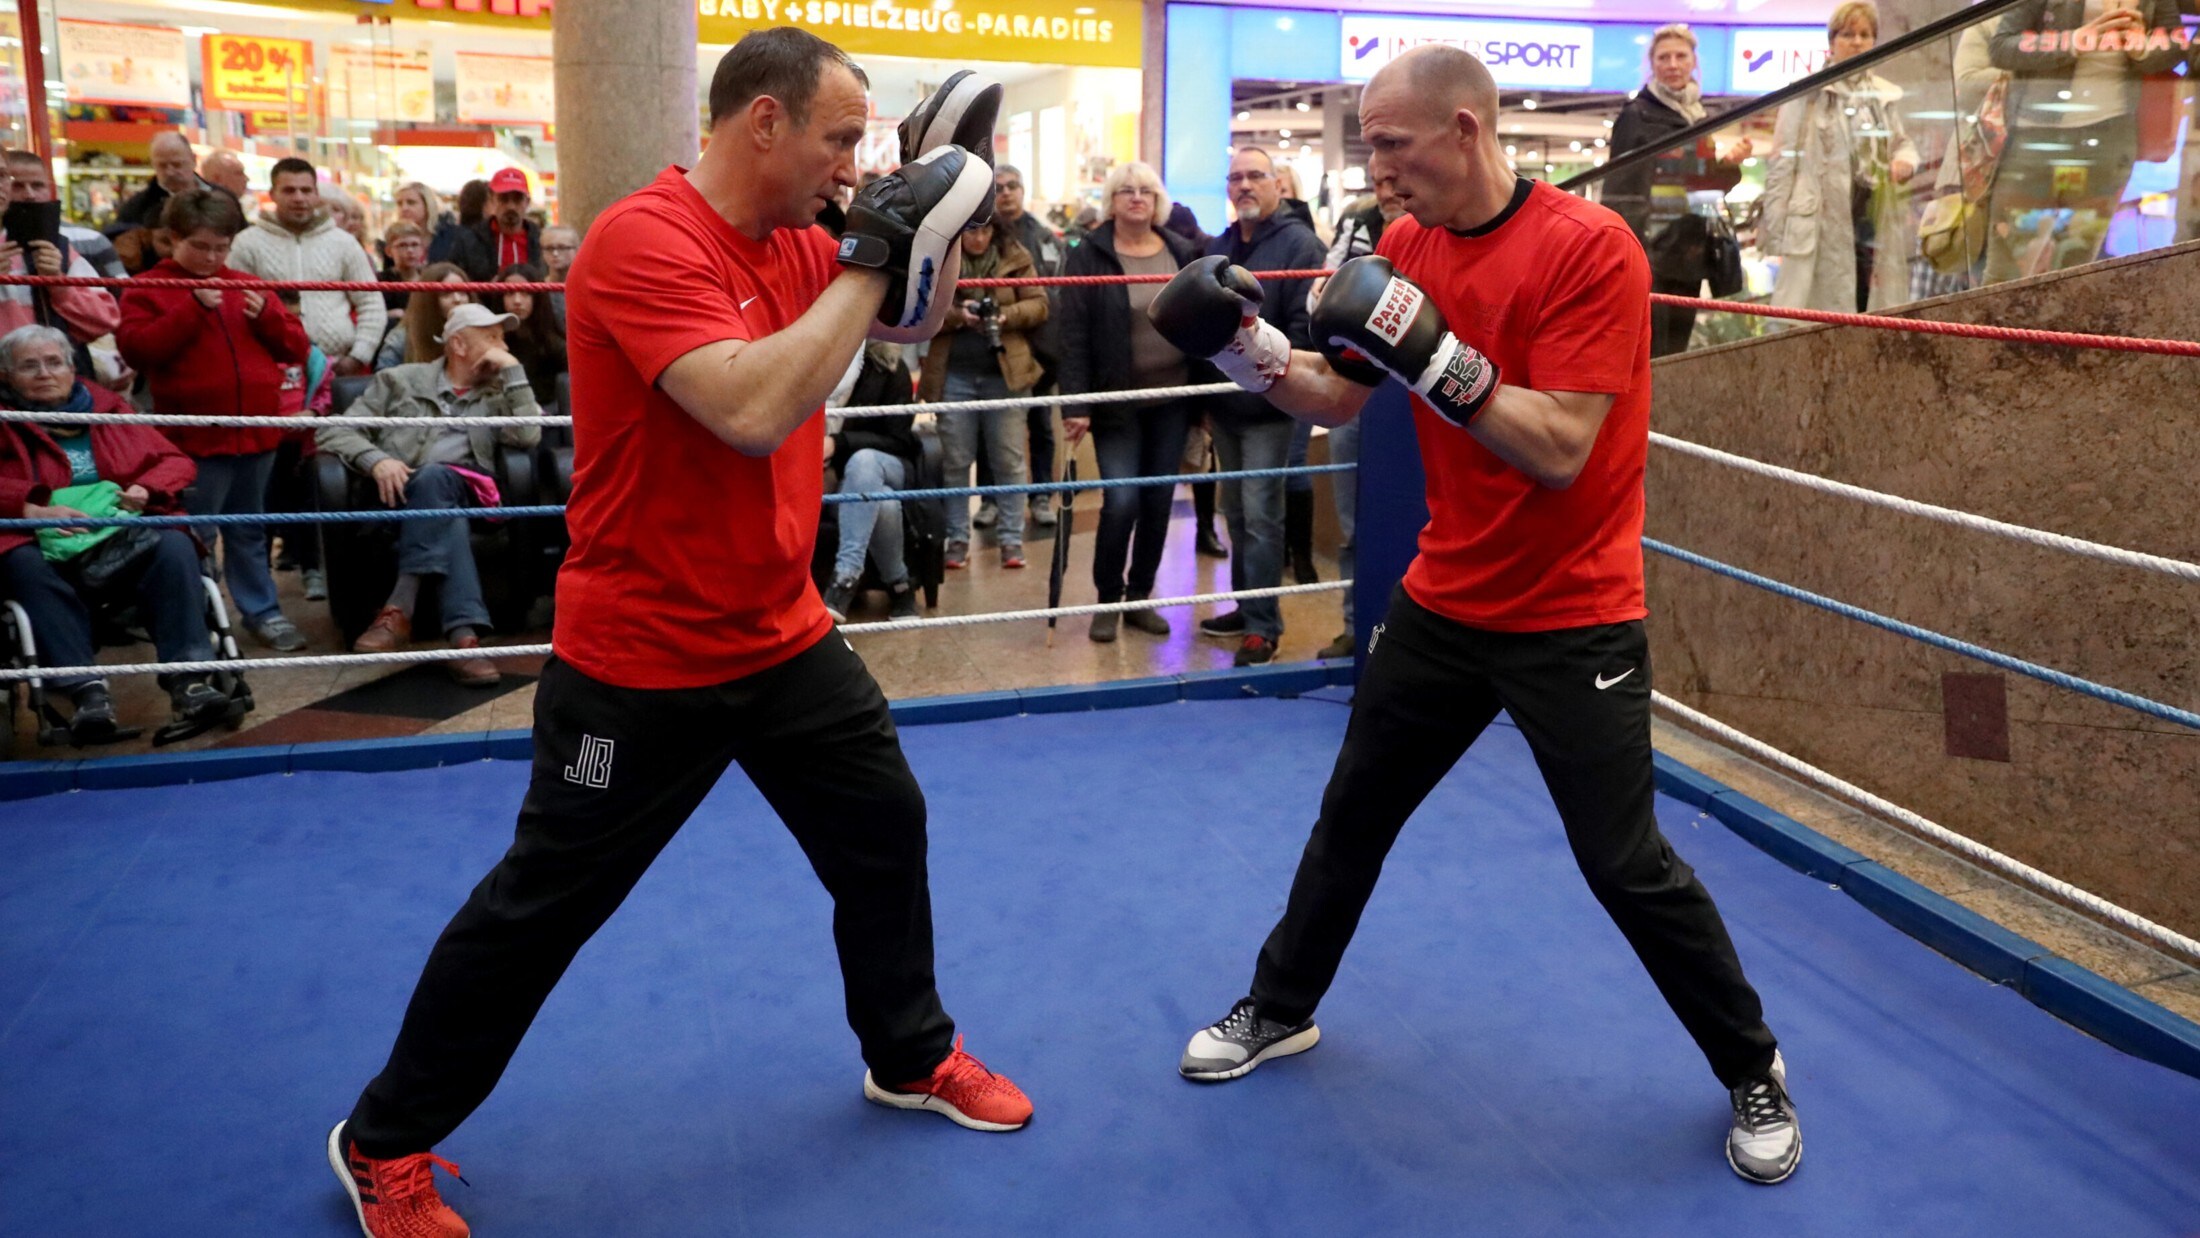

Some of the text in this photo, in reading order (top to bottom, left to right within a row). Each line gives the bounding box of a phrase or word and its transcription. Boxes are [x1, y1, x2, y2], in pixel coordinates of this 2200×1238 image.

[1372, 279, 1406, 330] PAFFEN
[1385, 287, 1418, 338] SPORT
[564, 733, 614, 788] JB
